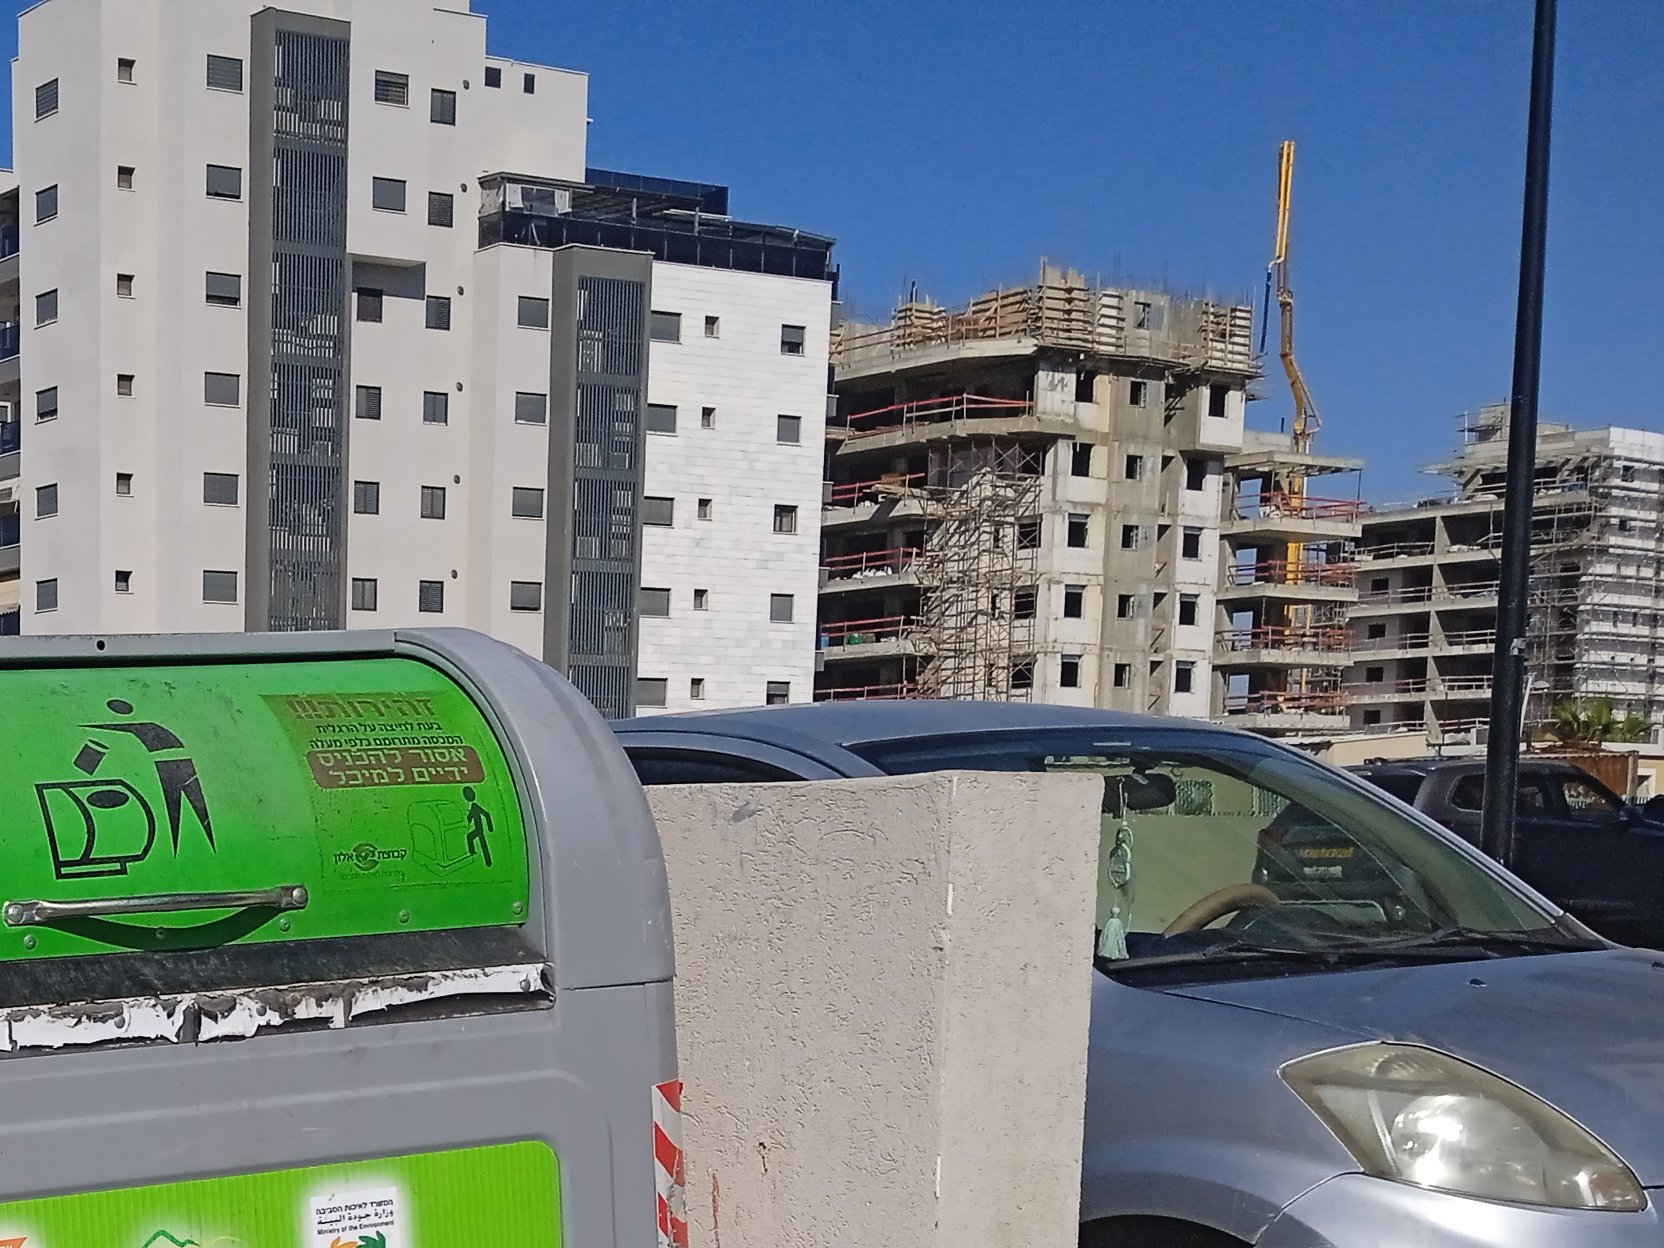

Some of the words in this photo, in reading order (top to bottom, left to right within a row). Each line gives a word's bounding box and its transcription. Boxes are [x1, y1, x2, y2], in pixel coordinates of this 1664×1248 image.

[359, 722, 376, 732] על
[417, 721, 443, 731] בעת
[309, 738, 342, 749] מעלה
[344, 736, 371, 747] כלפי
[374, 736, 420, 746] מתרומם
[421, 735, 464, 745] המכסה
[317, 748, 402, 767] להכניס
[409, 748, 467, 763] אסור
[328, 767, 405, 785] למיכל
[412, 766, 468, 782] ידיים
[333, 851, 354, 865] אלון
[377, 849, 407, 861] קבוצת
[369, 1199, 394, 1208] המשרד
[316, 1205, 343, 1215] הסביבה
[374, 1208, 393, 1219] وزارة
[348, 1212, 371, 1222] جودة
[317, 1227, 340, 1235] Ministry
[359, 1220, 394, 1230] Environment
